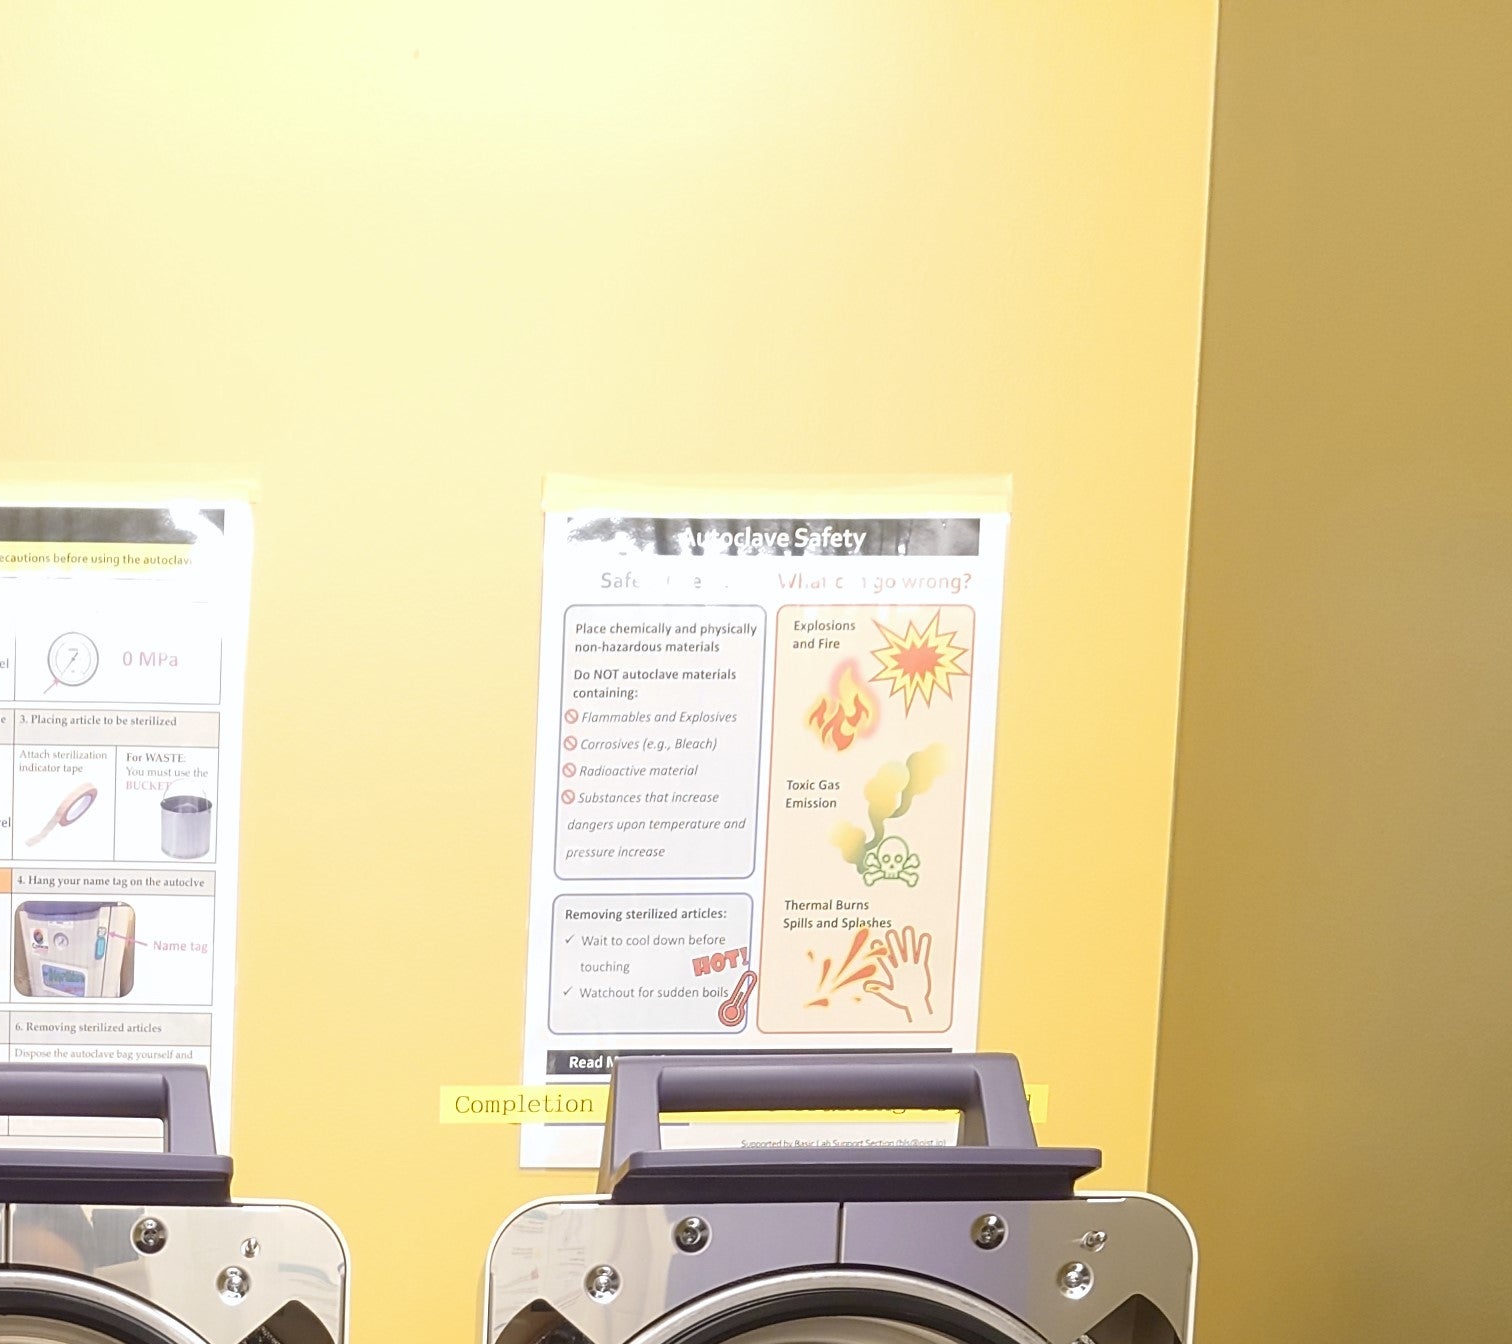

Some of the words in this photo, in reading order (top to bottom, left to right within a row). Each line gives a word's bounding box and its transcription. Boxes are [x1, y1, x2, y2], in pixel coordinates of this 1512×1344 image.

[795, 528, 866, 551] Safety
[53, 554, 88, 565] before
[91, 554, 119, 567] using
[123, 554, 140, 565] the
[575, 624, 607, 635] Place
[610, 623, 672, 637] chemically
[675, 624, 696, 635] and
[700, 623, 757, 637] physically
[794, 620, 856, 633] Explosions
[575, 641, 662, 653] non-hazardous
[665, 642, 719, 653] materials
[793, 639, 814, 649] and
[818, 639, 840, 649] Fire
[123, 651, 132, 666] 0
[139, 651, 178, 667] MPa
[786, 780, 815, 790] Toxic
[819, 780, 840, 790] Gas
[786, 798, 837, 809] Emission
[17, 876, 25, 885] 4.
[28, 876, 54, 889] Hang
[57, 878, 80, 889] your
[83, 877, 111, 887] name
[113, 877, 131, 889] tag
[132, 879, 143, 887] on
[146, 877, 161, 887] the
[164, 877, 204, 888] autoclve
[785, 899, 831, 911] Thermal
[835, 900, 869, 911] Burns
[565, 908, 621, 922] Removing
[625, 908, 678, 920] sterilized
[681, 908, 727, 920] articles:
[783, 917, 812, 931] Spills
[816, 917, 836, 929] and
[840, 917, 891, 931] Splashes
[692, 947, 749, 976] HOT!
[455, 1094, 594, 1116] Completion
